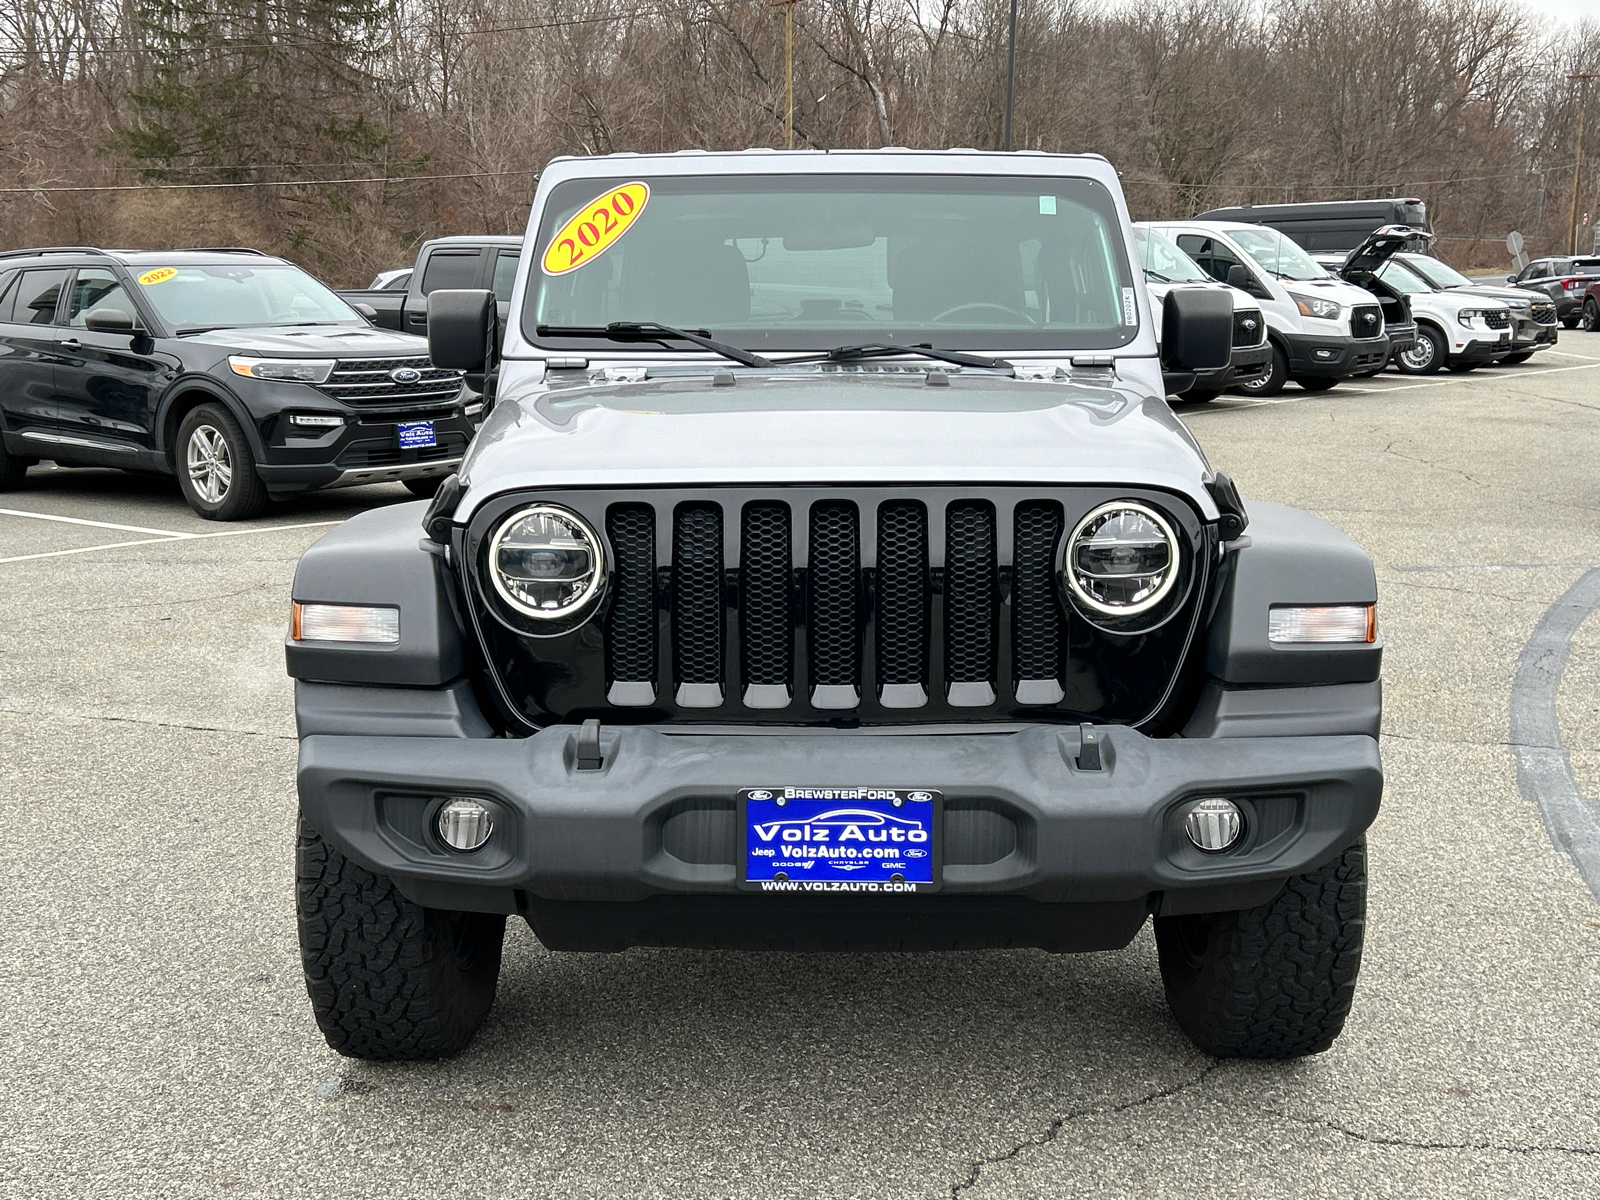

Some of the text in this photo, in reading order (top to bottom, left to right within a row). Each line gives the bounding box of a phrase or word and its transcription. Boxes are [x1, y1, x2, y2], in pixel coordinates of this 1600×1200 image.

[557, 192, 635, 266] 2020
[143, 268, 175, 283] 2022
[753, 824, 928, 842] Volz Auto
[752, 847, 776, 857] Jeep
[780, 845, 900, 858] VolzAuto.com
[761, 881, 917, 893] WWW.VOLZAUTO.COM
